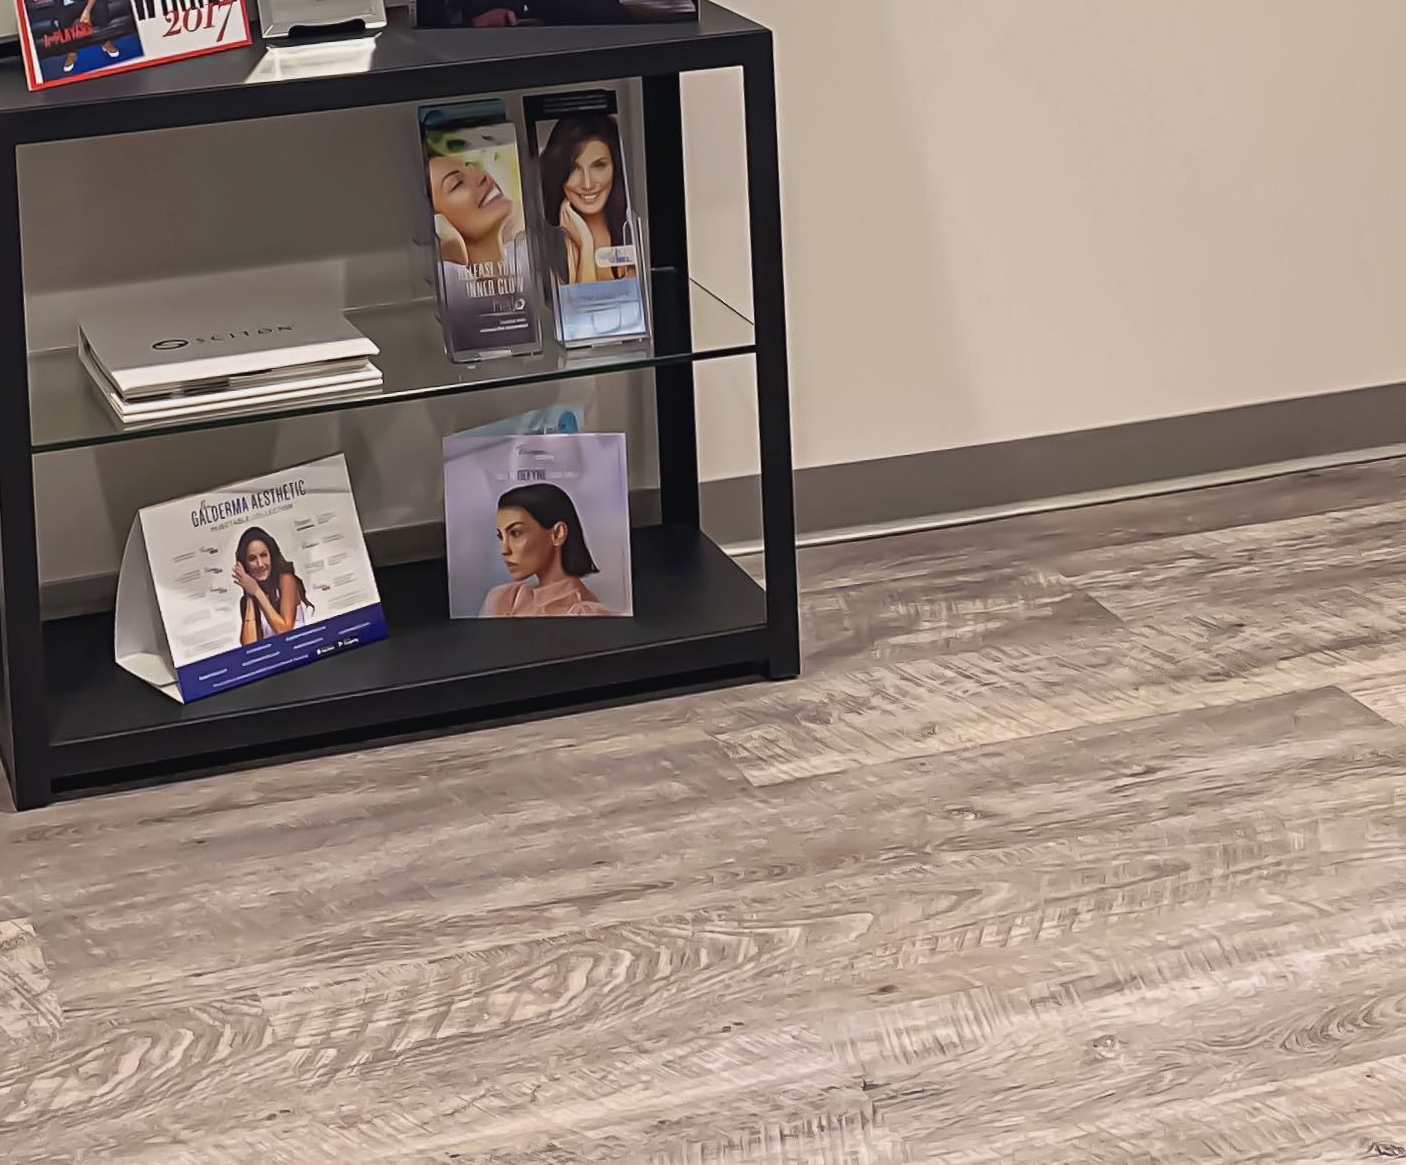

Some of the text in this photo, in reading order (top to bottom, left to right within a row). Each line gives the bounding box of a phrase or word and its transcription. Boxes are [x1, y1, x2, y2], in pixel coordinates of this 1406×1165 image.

[162, 0, 237, 42] 2017
[191, 479, 306, 527] GALDERMA AESTHETIC
